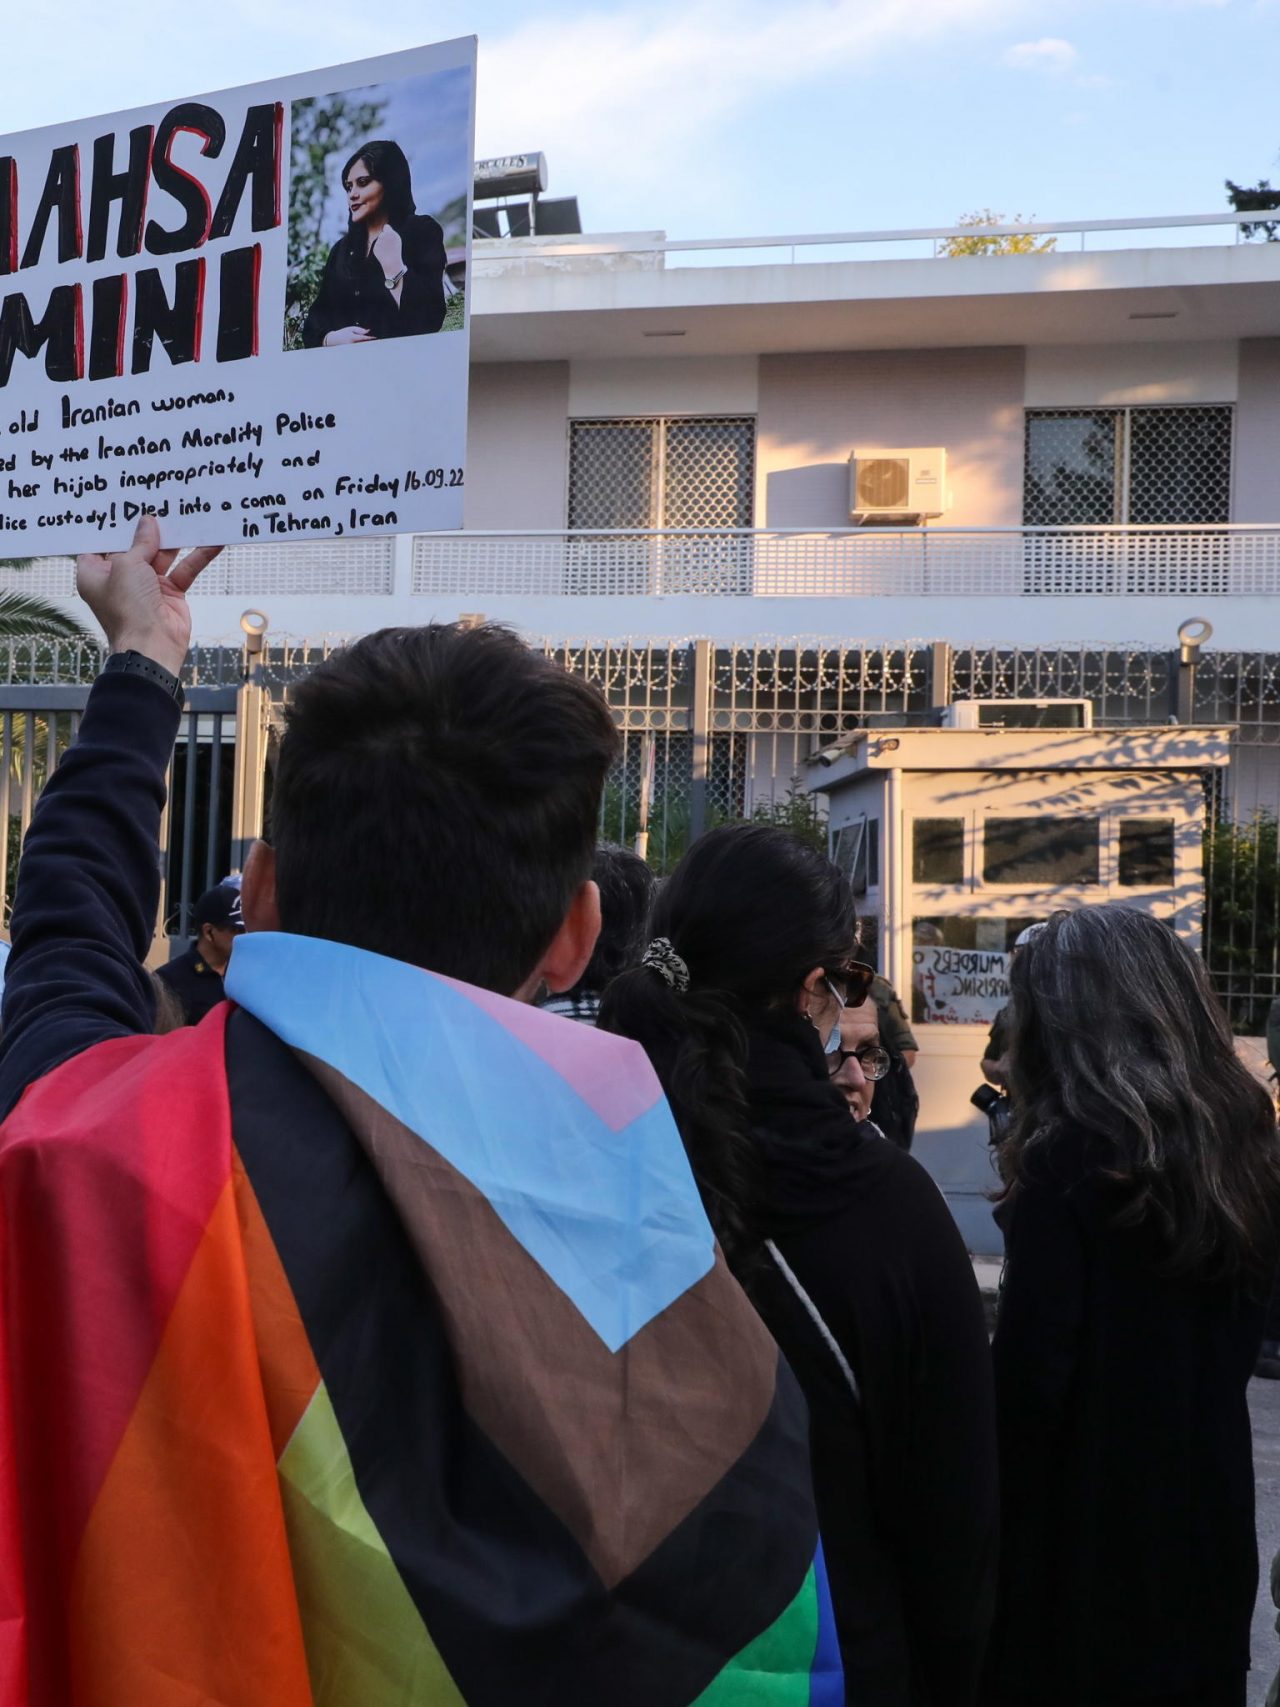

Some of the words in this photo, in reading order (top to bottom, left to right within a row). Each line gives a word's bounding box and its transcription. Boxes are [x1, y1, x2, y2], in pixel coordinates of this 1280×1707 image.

[8, 409, 39, 434] old
[61, 394, 141, 429] Iranian
[151, 388, 235, 412] woman,
[31, 450, 54, 471] by
[59, 447, 89, 463] the
[98, 435, 171, 460] Iranian
[181, 421, 263, 449] Morality
[276, 412, 336, 436] Police
[8, 479, 41, 499] her
[53, 474, 108, 499] hijab
[119, 451, 264, 490] inappropriately
[281, 449, 321, 468] and
[37, 502, 117, 531] custody!
[123, 499, 169, 522] Died
[179, 496, 212, 516] into
[221, 501, 232, 512] a
[240, 493, 287, 509] coma
[302, 487, 325, 501] on
[335, 473, 400, 499] Friday
[404, 467, 465, 492] 16.09.22
[242, 517, 260, 538] in
[349, 508, 398, 529] Iran
